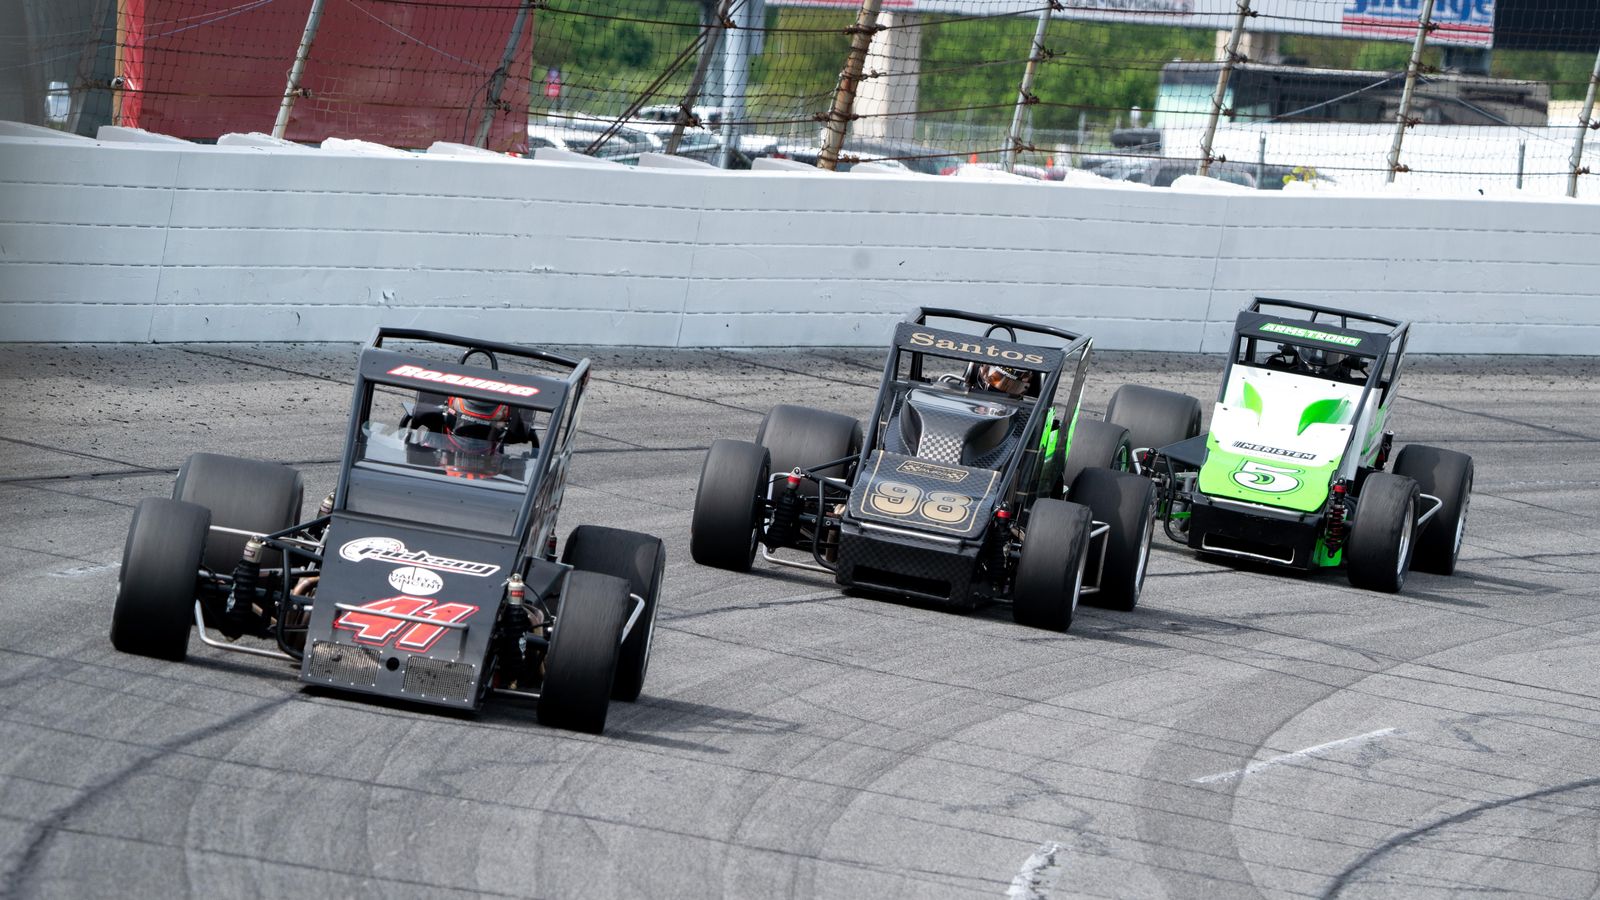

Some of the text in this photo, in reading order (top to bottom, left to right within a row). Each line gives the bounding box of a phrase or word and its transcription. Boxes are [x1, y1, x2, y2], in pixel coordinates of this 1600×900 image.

[909, 332, 1044, 364] Santos
[1264, 323, 1358, 345] ARMSTRONG
[389, 365, 539, 396] ROAHRIG
[1240, 442, 1316, 460] MERISTEM
[1233, 460, 1300, 493] 5
[870, 481, 974, 524] 98
[333, 595, 479, 652] 41
